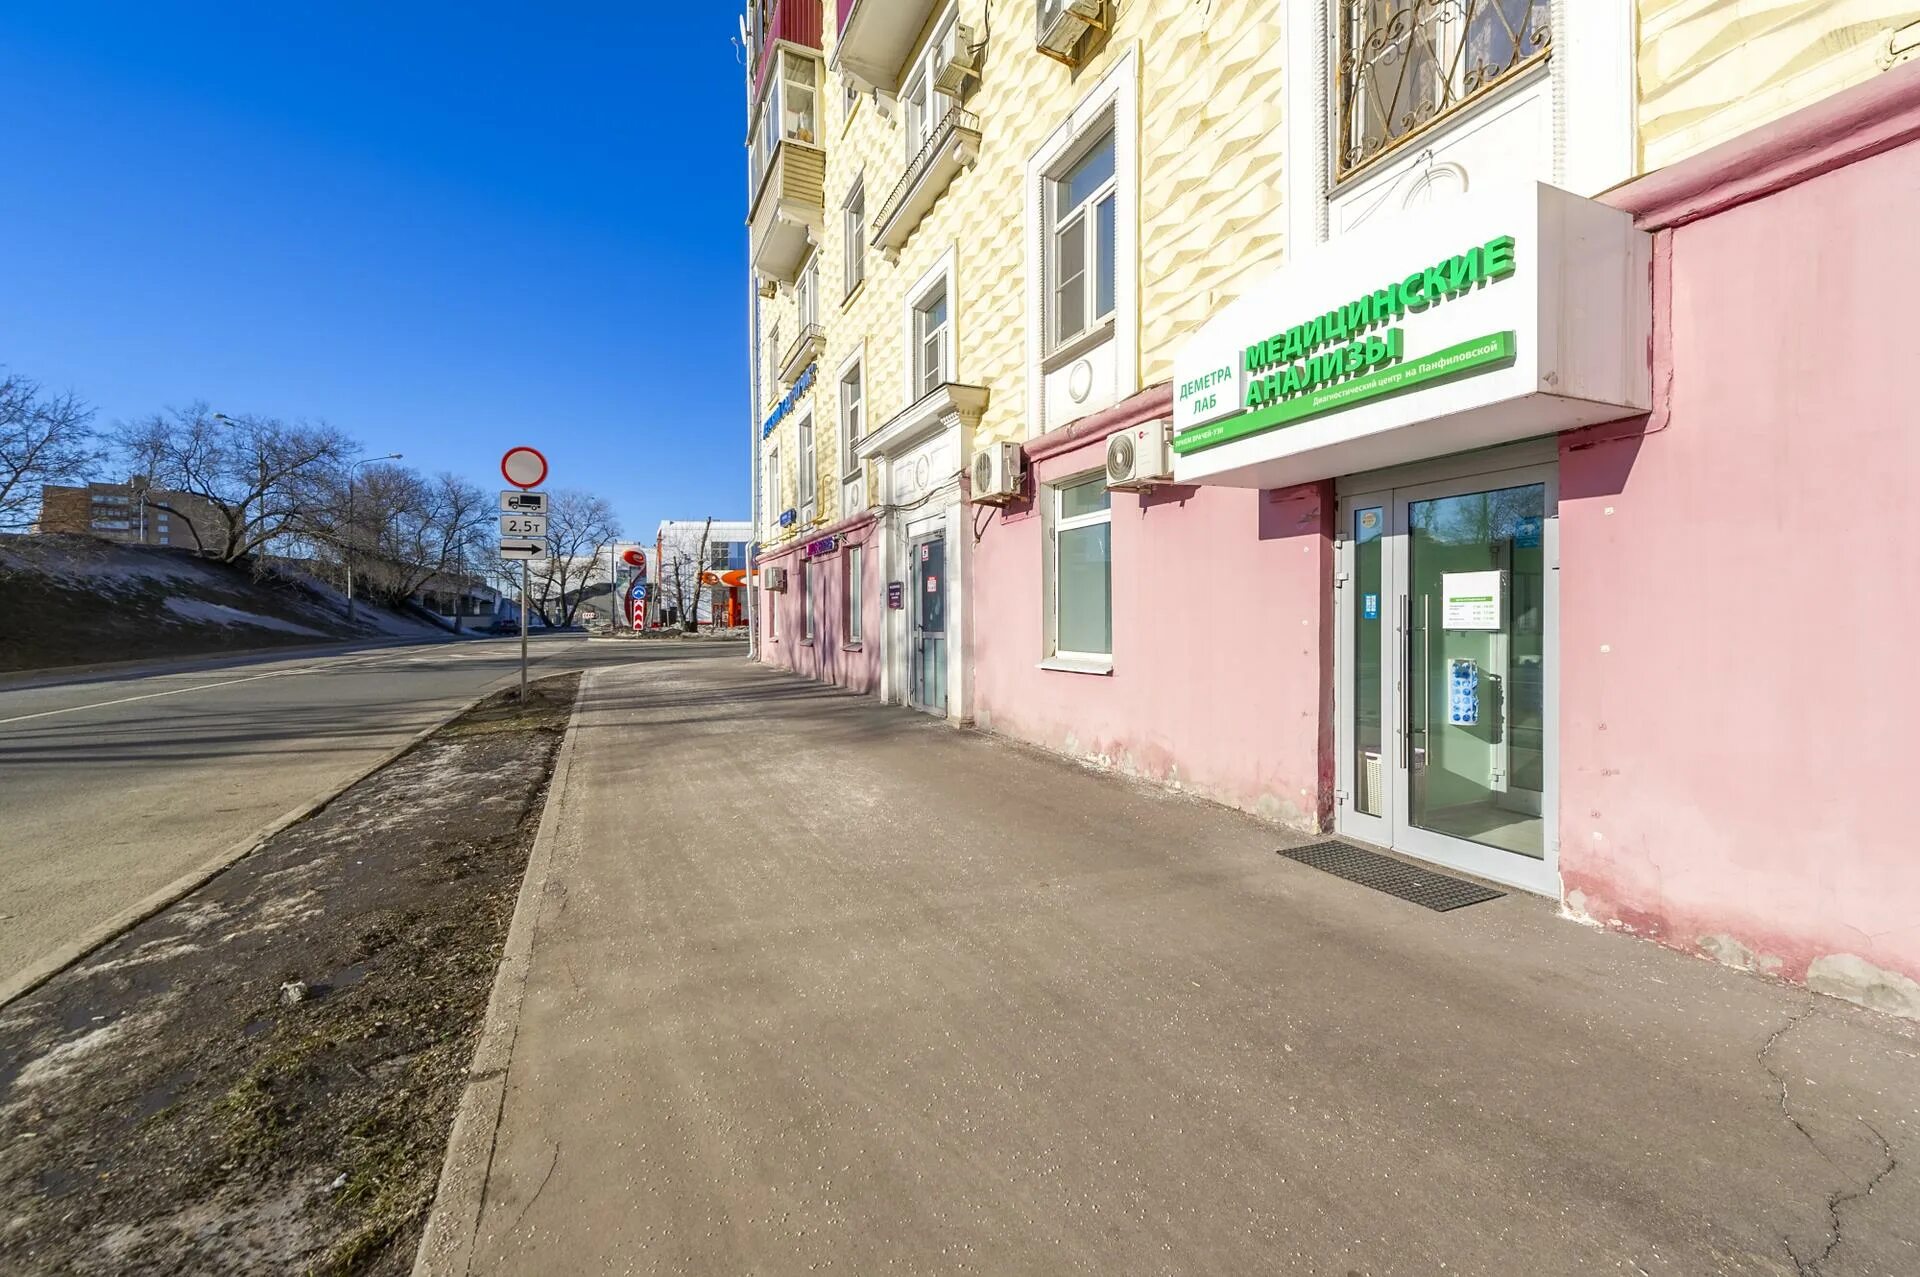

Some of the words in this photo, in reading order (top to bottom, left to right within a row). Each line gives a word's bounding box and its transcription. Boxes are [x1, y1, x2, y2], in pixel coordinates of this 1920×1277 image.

[1245, 235, 1516, 372] МЕДИЦИНСКИЕ
[1179, 364, 1233, 402] ДЕМЕТРА
[1246, 327, 1404, 406] АНАЛИЗЫ
[1313, 380, 1377, 407] Диагностический
[1378, 373, 1403, 388] центр
[1405, 368, 1417, 379] на
[1418, 340, 1498, 375] Панфиловской
[1193, 395, 1217, 415] ЛАБ
